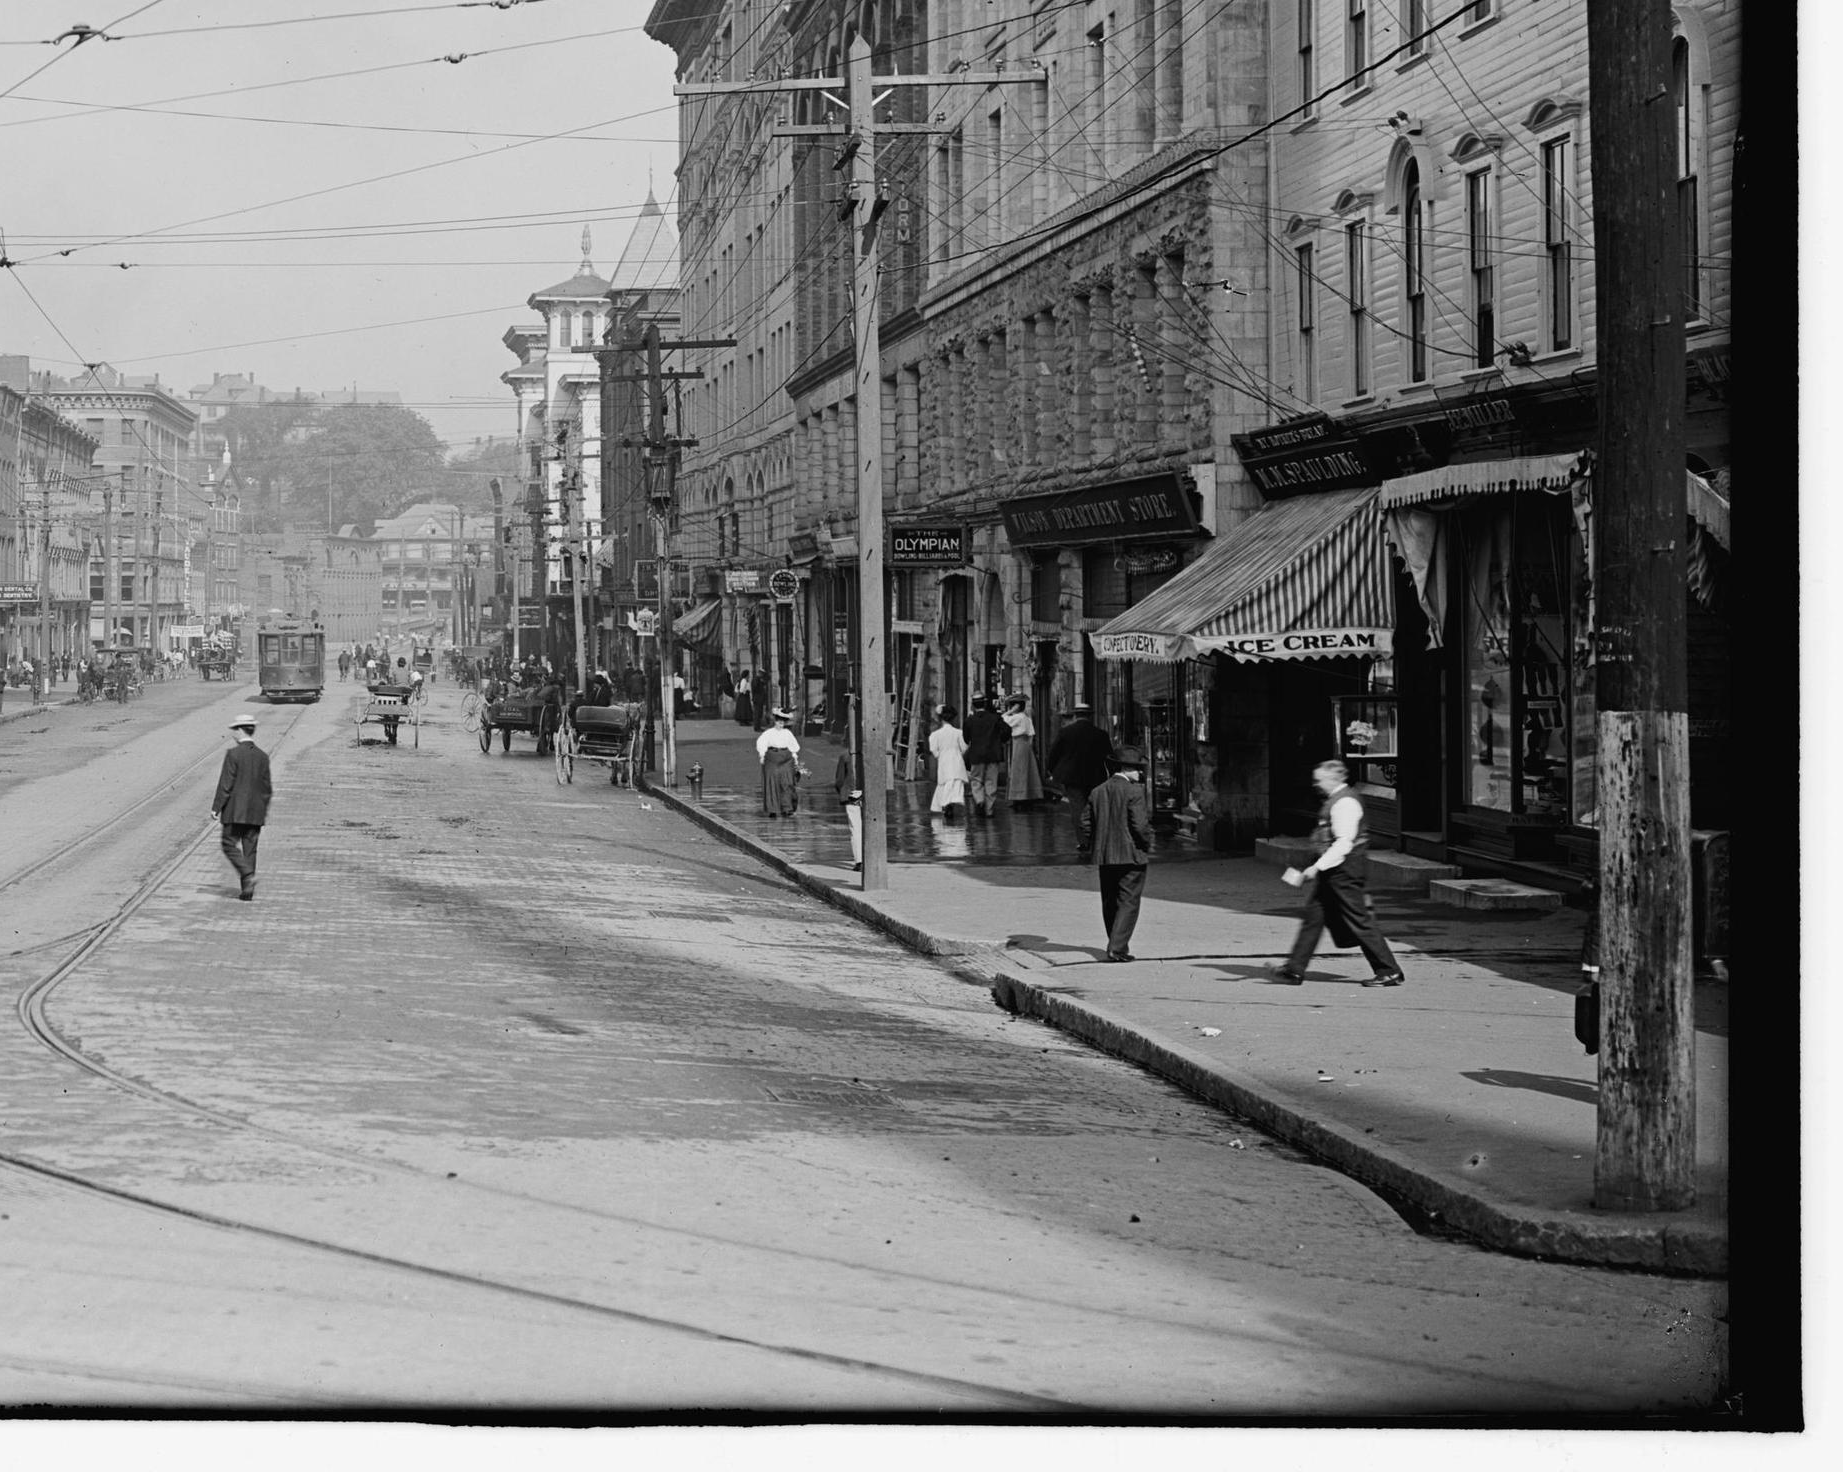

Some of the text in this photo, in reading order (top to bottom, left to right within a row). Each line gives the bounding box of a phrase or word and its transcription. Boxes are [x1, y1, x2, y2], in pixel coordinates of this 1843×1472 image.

[1052, 499, 1125, 531] DEPARTMENT
[1128, 492, 1177, 522] STORE.
[895, 538, 960, 550] OLYMPIAN
[1228, 638, 1276, 654] ICE
[1284, 633, 1376, 651] CREAM
